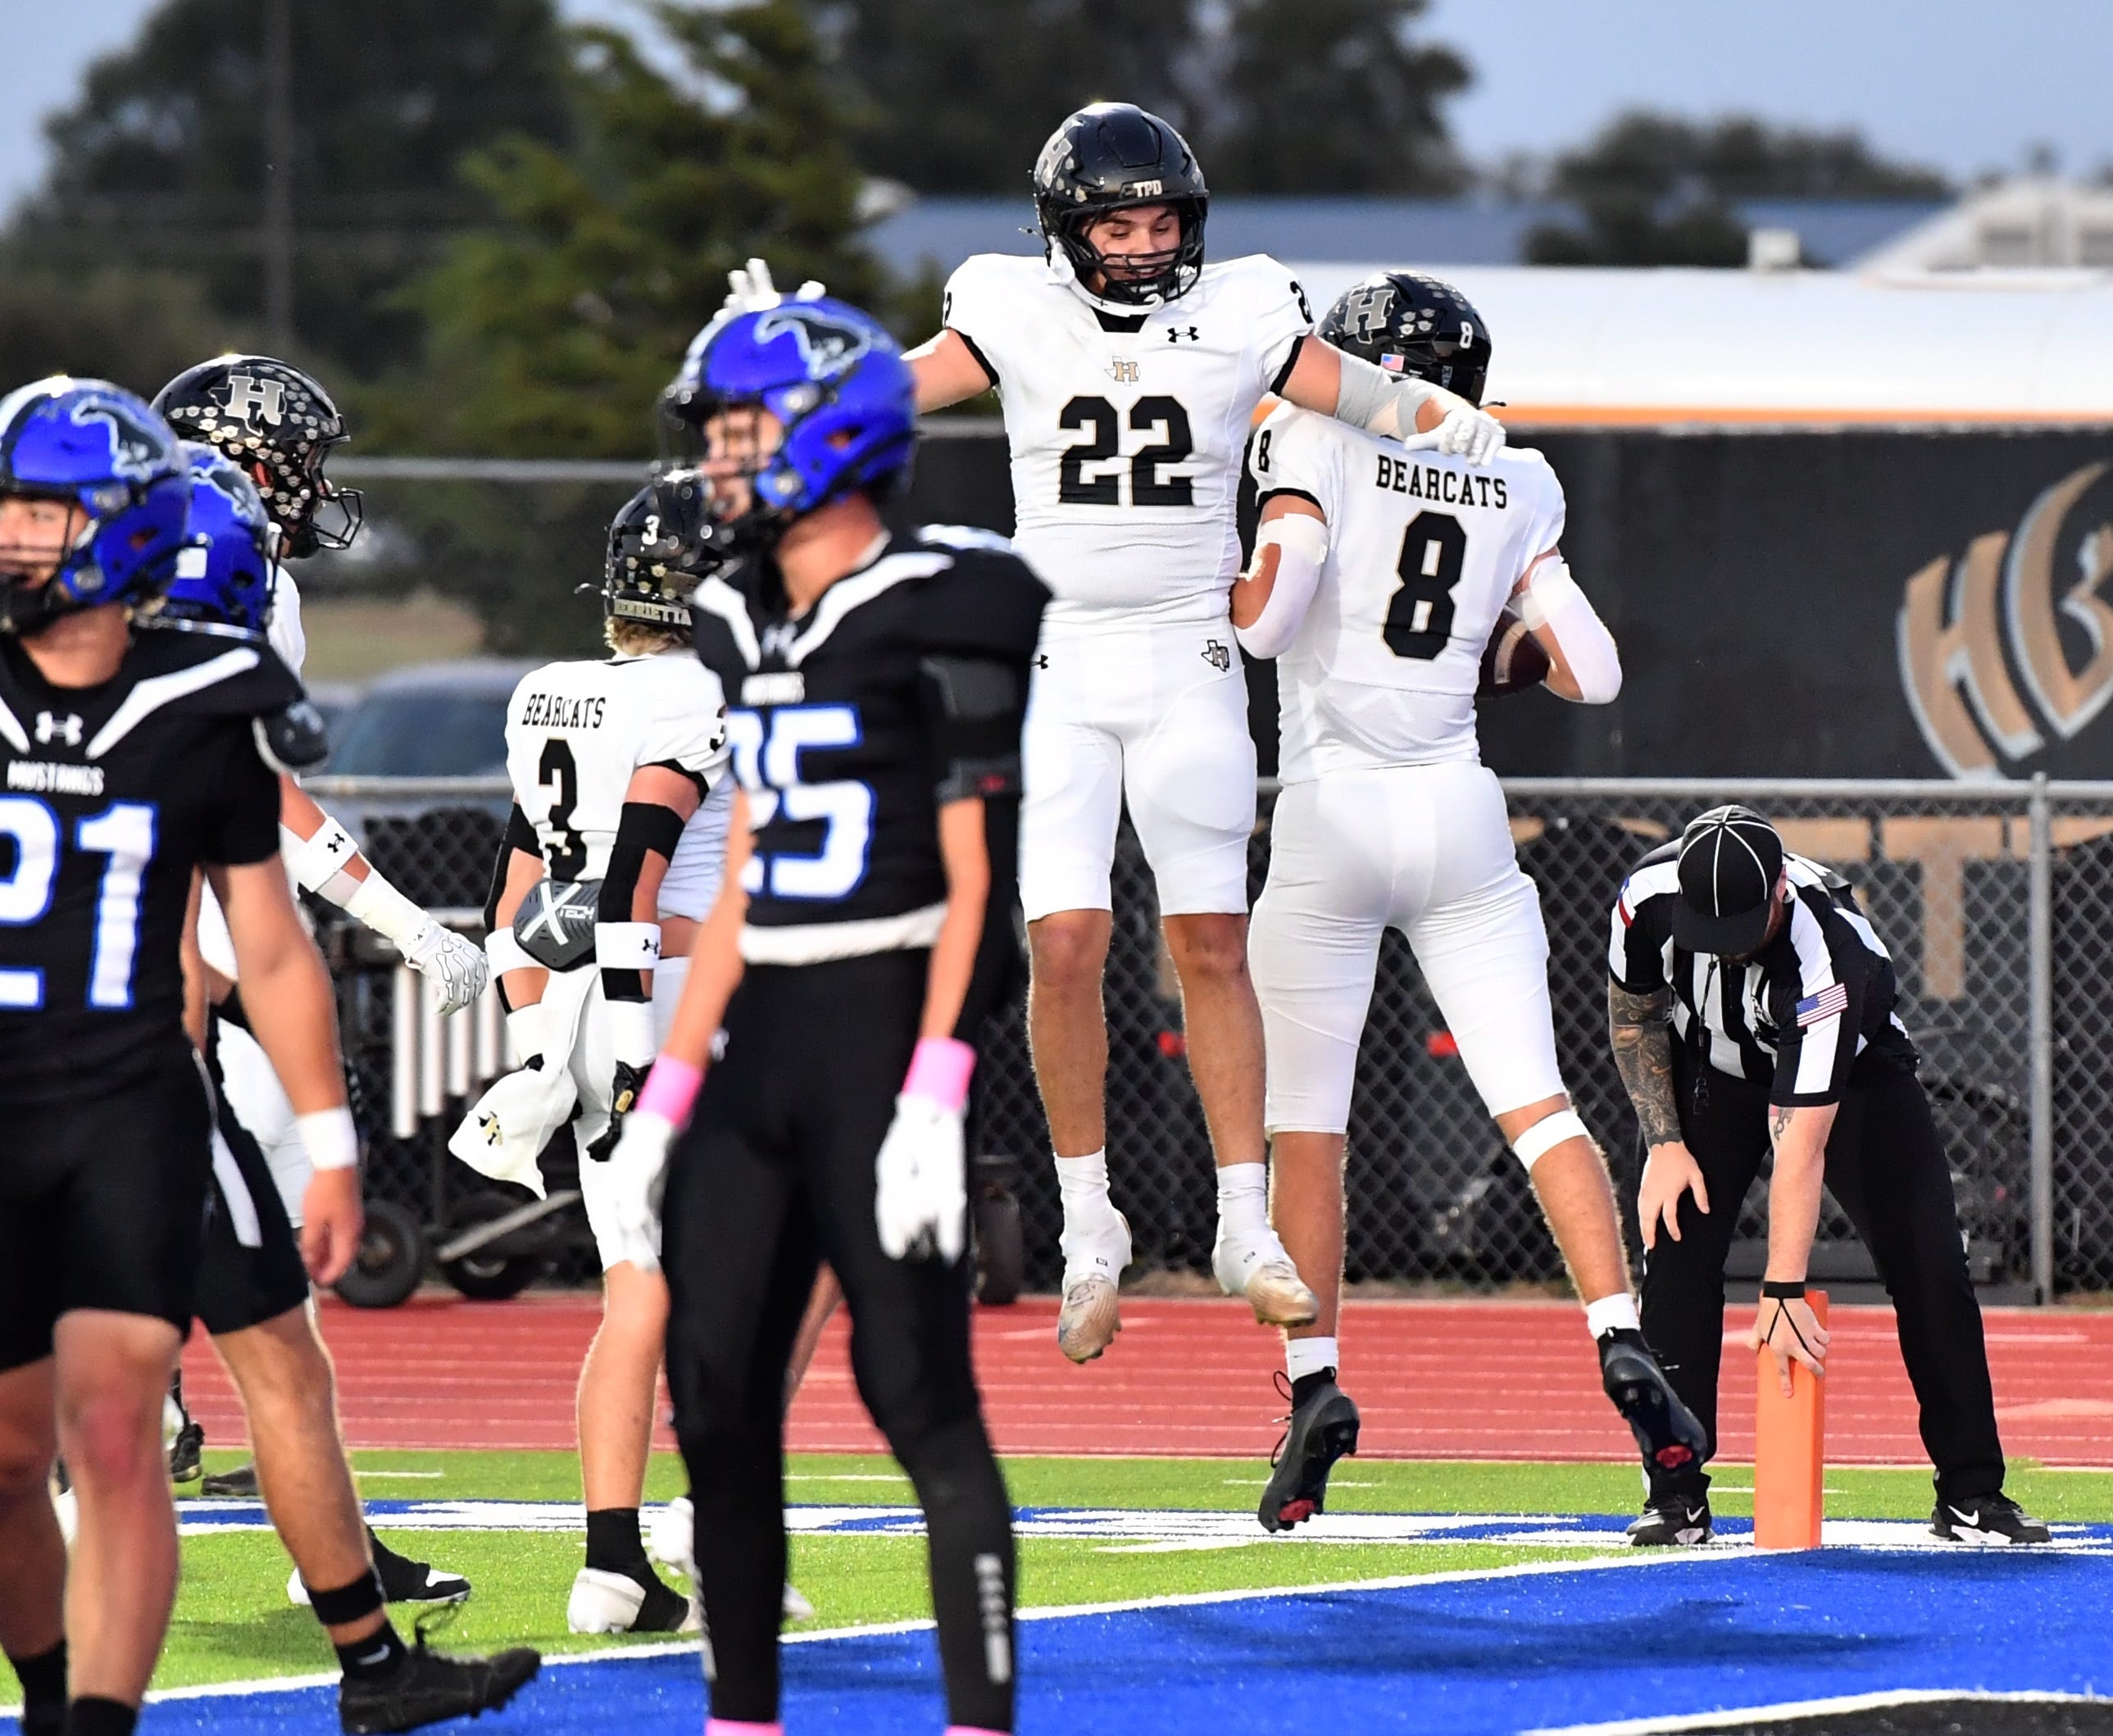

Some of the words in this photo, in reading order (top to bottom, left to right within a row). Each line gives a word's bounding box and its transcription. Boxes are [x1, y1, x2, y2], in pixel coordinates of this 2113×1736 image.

[1344, 289, 1395, 336] H
[1459, 321, 1474, 349] 8
[1114, 361, 1138, 381] H
[225, 375, 285, 425] H
[1057, 394, 1195, 507] 22
[1258, 429, 1271, 473] 8
[1376, 454, 1507, 509] BEARCATS
[642, 515, 660, 545] 3
[1379, 508, 1467, 662] 8
[521, 693, 606, 729] BEARCATS
[538, 737, 587, 882] 3
[0, 793, 161, 1012] 21
